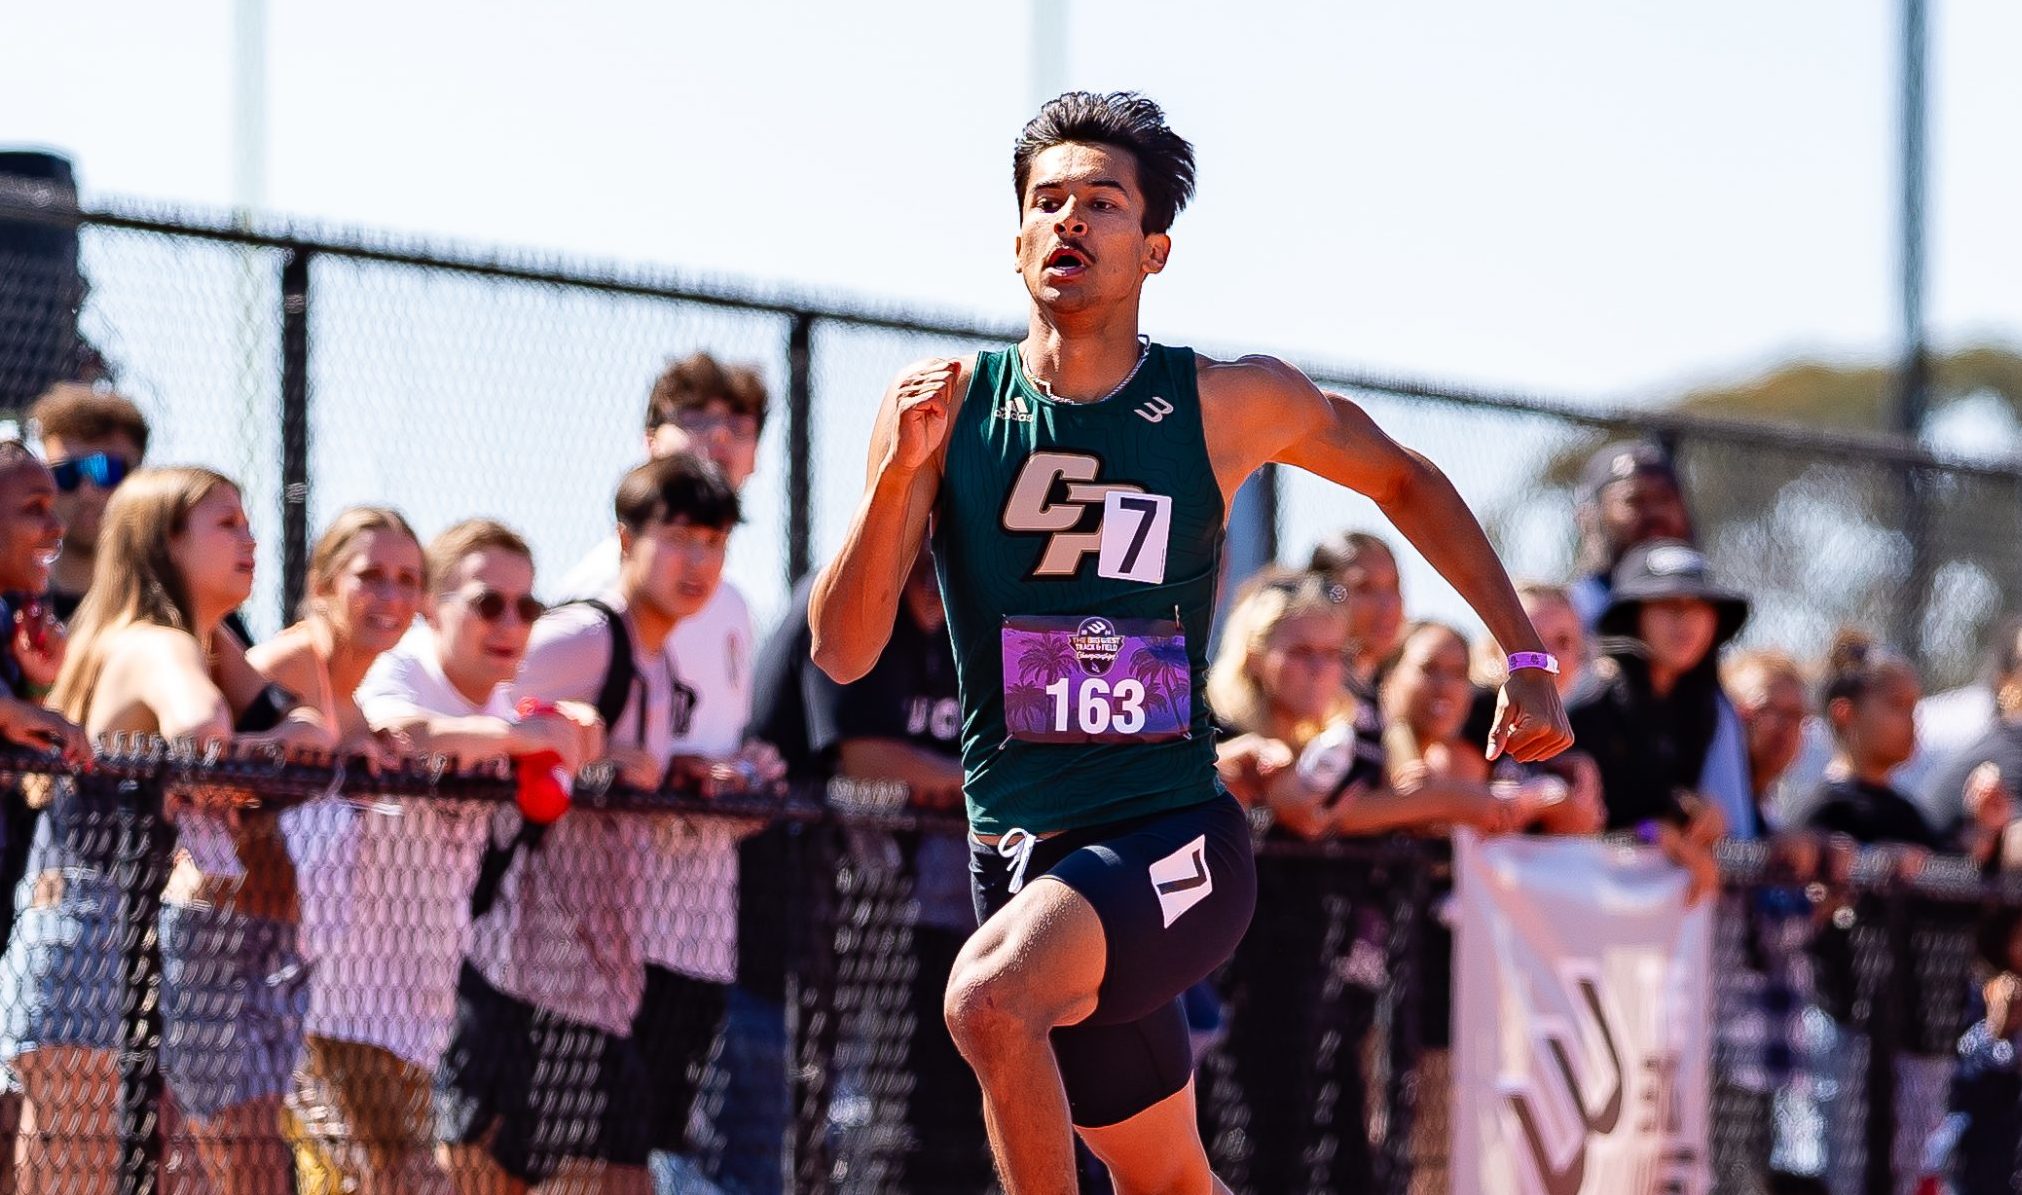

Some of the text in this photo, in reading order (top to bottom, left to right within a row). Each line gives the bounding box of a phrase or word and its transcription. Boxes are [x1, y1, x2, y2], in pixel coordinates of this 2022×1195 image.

[994, 407, 1034, 422] adidas
[1119, 497, 1158, 574] 7
[1046, 678, 1146, 735] 163
